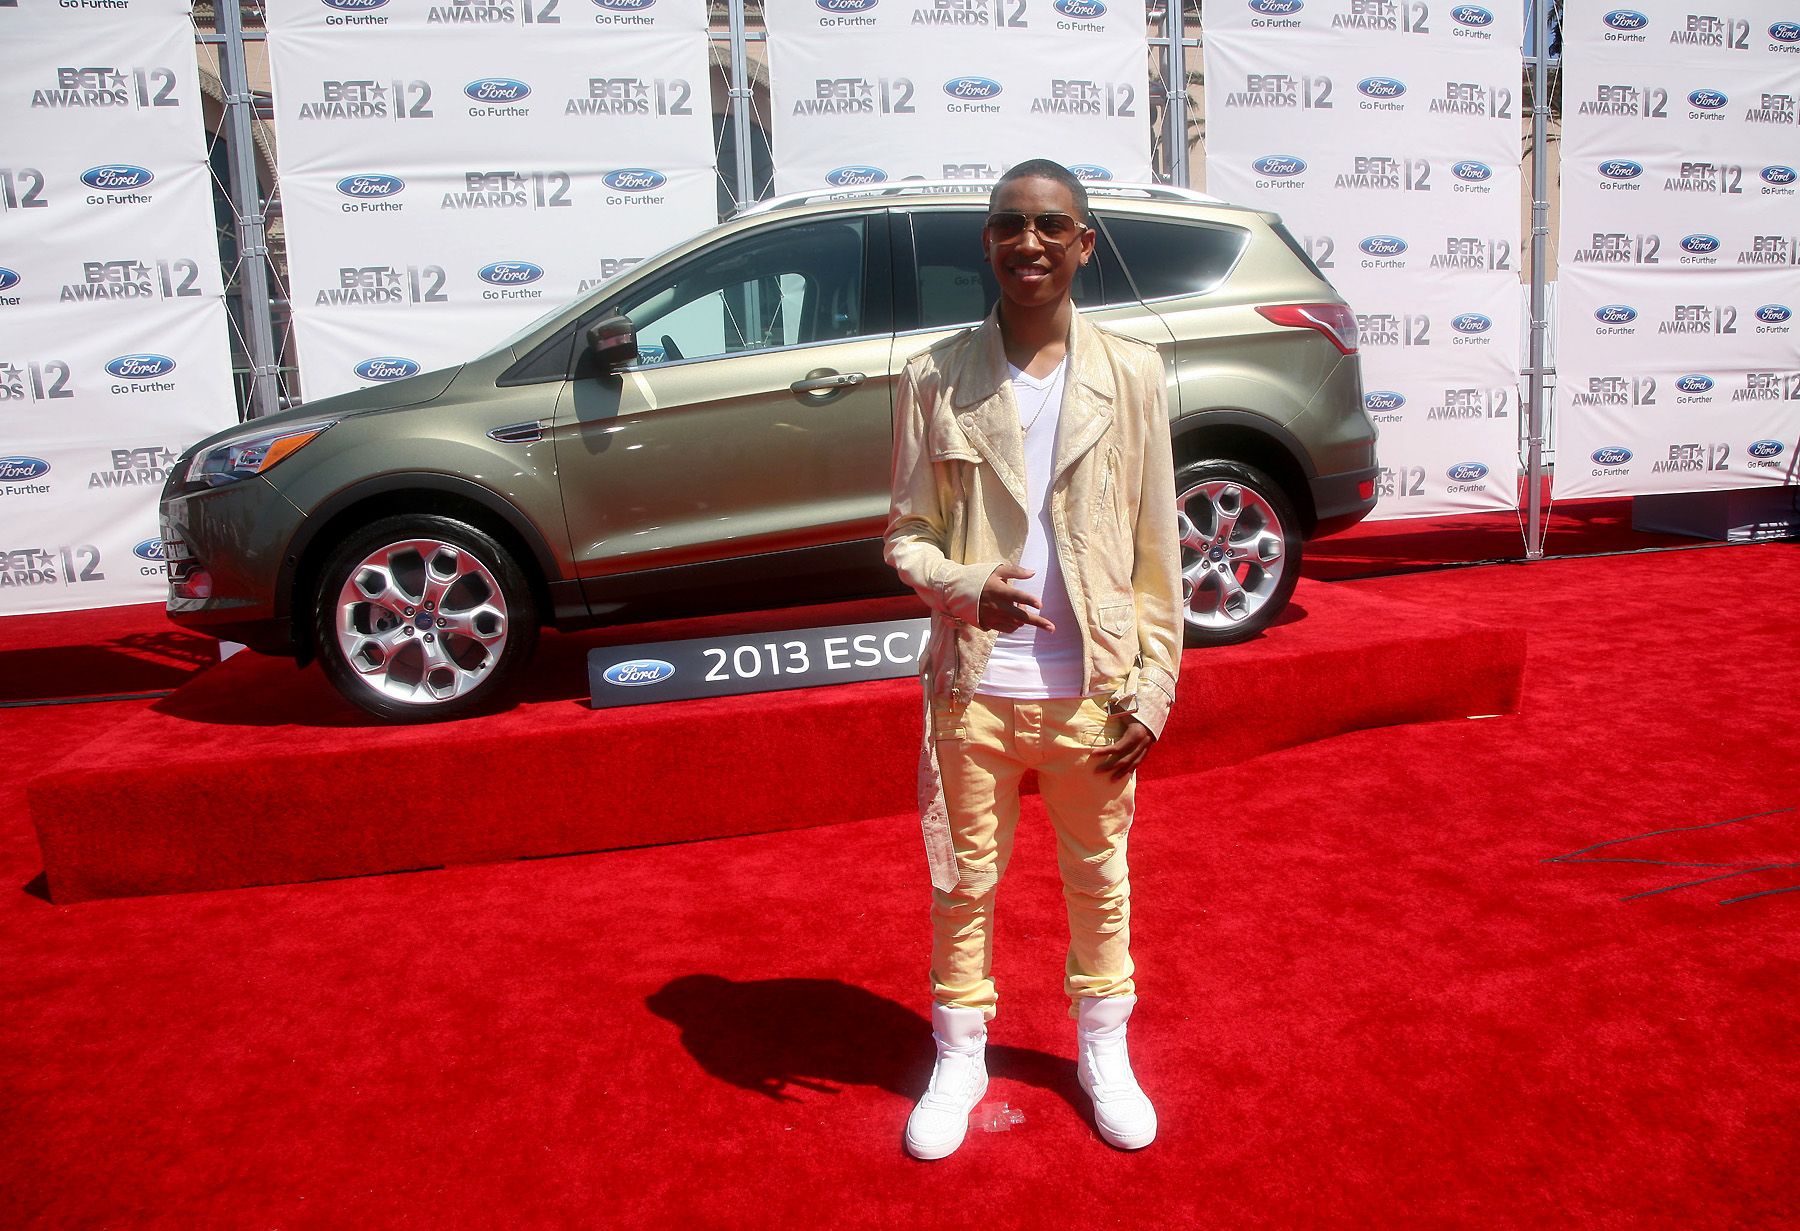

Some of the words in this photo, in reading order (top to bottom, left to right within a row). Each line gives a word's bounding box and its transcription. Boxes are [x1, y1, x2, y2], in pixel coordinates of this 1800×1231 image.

[1064, 0, 1096, 15] Ford
[1260, 0, 1292, 11] Ford
[325, 16, 343, 25] Go
[345, 15, 388, 25] Further
[427, 6, 515, 24] AWARDS
[595, 15, 612, 24] Go
[614, 15, 655, 25] Further
[820, 17, 836, 27] Go
[837, 17, 876, 26] Further
[911, 9, 989, 26] AWARDS
[1331, 14, 1397, 31] AWARDS
[1612, 12, 1640, 27] Ford
[1057, 21, 1070, 30] Go
[1072, 22, 1105, 32] Further
[1251, 19, 1265, 28] Go
[1266, 19, 1301, 28] Further
[1687, 15, 1717, 31] BET
[1453, 28, 1464, 37] Go
[1465, 30, 1491, 39] Further
[1604, 33, 1617, 41] Go
[1617, 33, 1646, 42] Further
[1670, 31, 1722, 46] AWARDS
[1768, 44, 1778, 52] Go
[1780, 45, 1800, 54] Furthe
[57, 68, 113, 89] BET
[1247, 74, 1289, 92] BET
[323, 81, 374, 101] BET
[589, 78, 637, 98] BET
[816, 78, 862, 98] BET
[955, 80, 991, 96] Ford
[1052, 80, 1092, 99] BET
[1447, 82, 1479, 100] BET
[1597, 85, 1632, 102] BET
[31, 89, 129, 109] AWARDS
[1030, 98, 1101, 115] AWARDS
[1225, 92, 1296, 108] AWARDS
[1359, 101, 1373, 110] Go
[1374, 102, 1404, 111] Further
[1761, 93, 1791, 110] BET
[299, 102, 387, 120] AWARDS
[469, 108, 485, 116] Go
[488, 107, 529, 116] Further
[564, 99, 649, 116] AWARDS
[792, 98, 873, 116] AWARDS
[947, 104, 962, 113] Go
[964, 104, 1000, 113] Further
[1429, 98, 1485, 116] AWARDS
[1578, 101, 1638, 116] AWARDS
[1689, 112, 1699, 120] Go
[1700, 112, 1725, 121] Further
[1745, 109, 1793, 124] AWARDS
[1263, 158, 1296, 172] Ford
[1354, 156, 1392, 174] BET
[1680, 162, 1711, 178] BET
[465, 171, 515, 191] BET
[1334, 174, 1399, 190] AWARDS
[1767, 168, 1791, 182] Ford
[351, 178, 390, 193] Ford
[1255, 180, 1269, 188] Go
[1271, 180, 1305, 189] Further
[1453, 184, 1464, 192] Go
[1465, 185, 1490, 194] Further
[1599, 182, 1611, 190] Go
[1663, 179, 1716, 192] AWARDS
[1761, 187, 1770, 195] Go
[86, 195, 104, 205] Go
[107, 193, 152, 204] Further
[440, 192, 527, 209] AWARDS
[606, 196, 622, 205] Go
[624, 196, 664, 205] Further
[342, 203, 359, 212] Go
[361, 202, 403, 211] Further
[1447, 238, 1474, 254] BET
[1592, 233, 1626, 249] BET
[1753, 236, 1782, 251] BET
[1361, 260, 1374, 268] Go
[1376, 260, 1406, 268] Further
[1429, 255, 1484, 269] AWARDS
[1573, 250, 1631, 263] AWARDS
[1692, 256, 1717, 264] Further
[1737, 252, 1786, 265] AWARDS
[83, 261, 130, 283] BET
[339, 267, 389, 288] BET
[492, 266, 531, 281] Ford
[60, 284, 153, 302] AWARDS
[315, 288, 402, 307] AWARDS
[483, 289, 499, 300] Go
[502, 288, 542, 300] Further
[1674, 305, 1705, 321] BET
[1459, 316, 1484, 330] Ford
[1658, 320, 1710, 334] AWARDS
[1767, 326, 1790, 334] Further
[1608, 327, 1635, 335] Further
[1452, 337, 1464, 345] Go
[1465, 337, 1490, 345] Further
[111, 385, 129, 395] Go
[131, 381, 175, 394] Further
[1589, 377, 1621, 393] BET
[1683, 377, 1706, 390] Ford
[1747, 373, 1775, 388] BET
[1444, 389, 1475, 406] BET
[1571, 393, 1627, 407] AWARDS
[1732, 389, 1779, 402] AWARDS
[1427, 406, 1482, 420] AWARDS
[110, 447, 164, 470] BET
[1599, 450, 1625, 463] Ford
[1669, 444, 1700, 460] BET
[1651, 460, 1703, 473] AWARDS
[1758, 460, 1781, 468] Further
[1591, 468, 1603, 477] Go
[1604, 468, 1630, 476] Further
[6, 484, 50, 496] Further
[1447, 485, 1458, 493] Go
[1459, 485, 1486, 493] Further
[140, 566, 157, 576] Go
[702, 641, 810, 682] 2013
[618, 664, 661, 682] Ford
